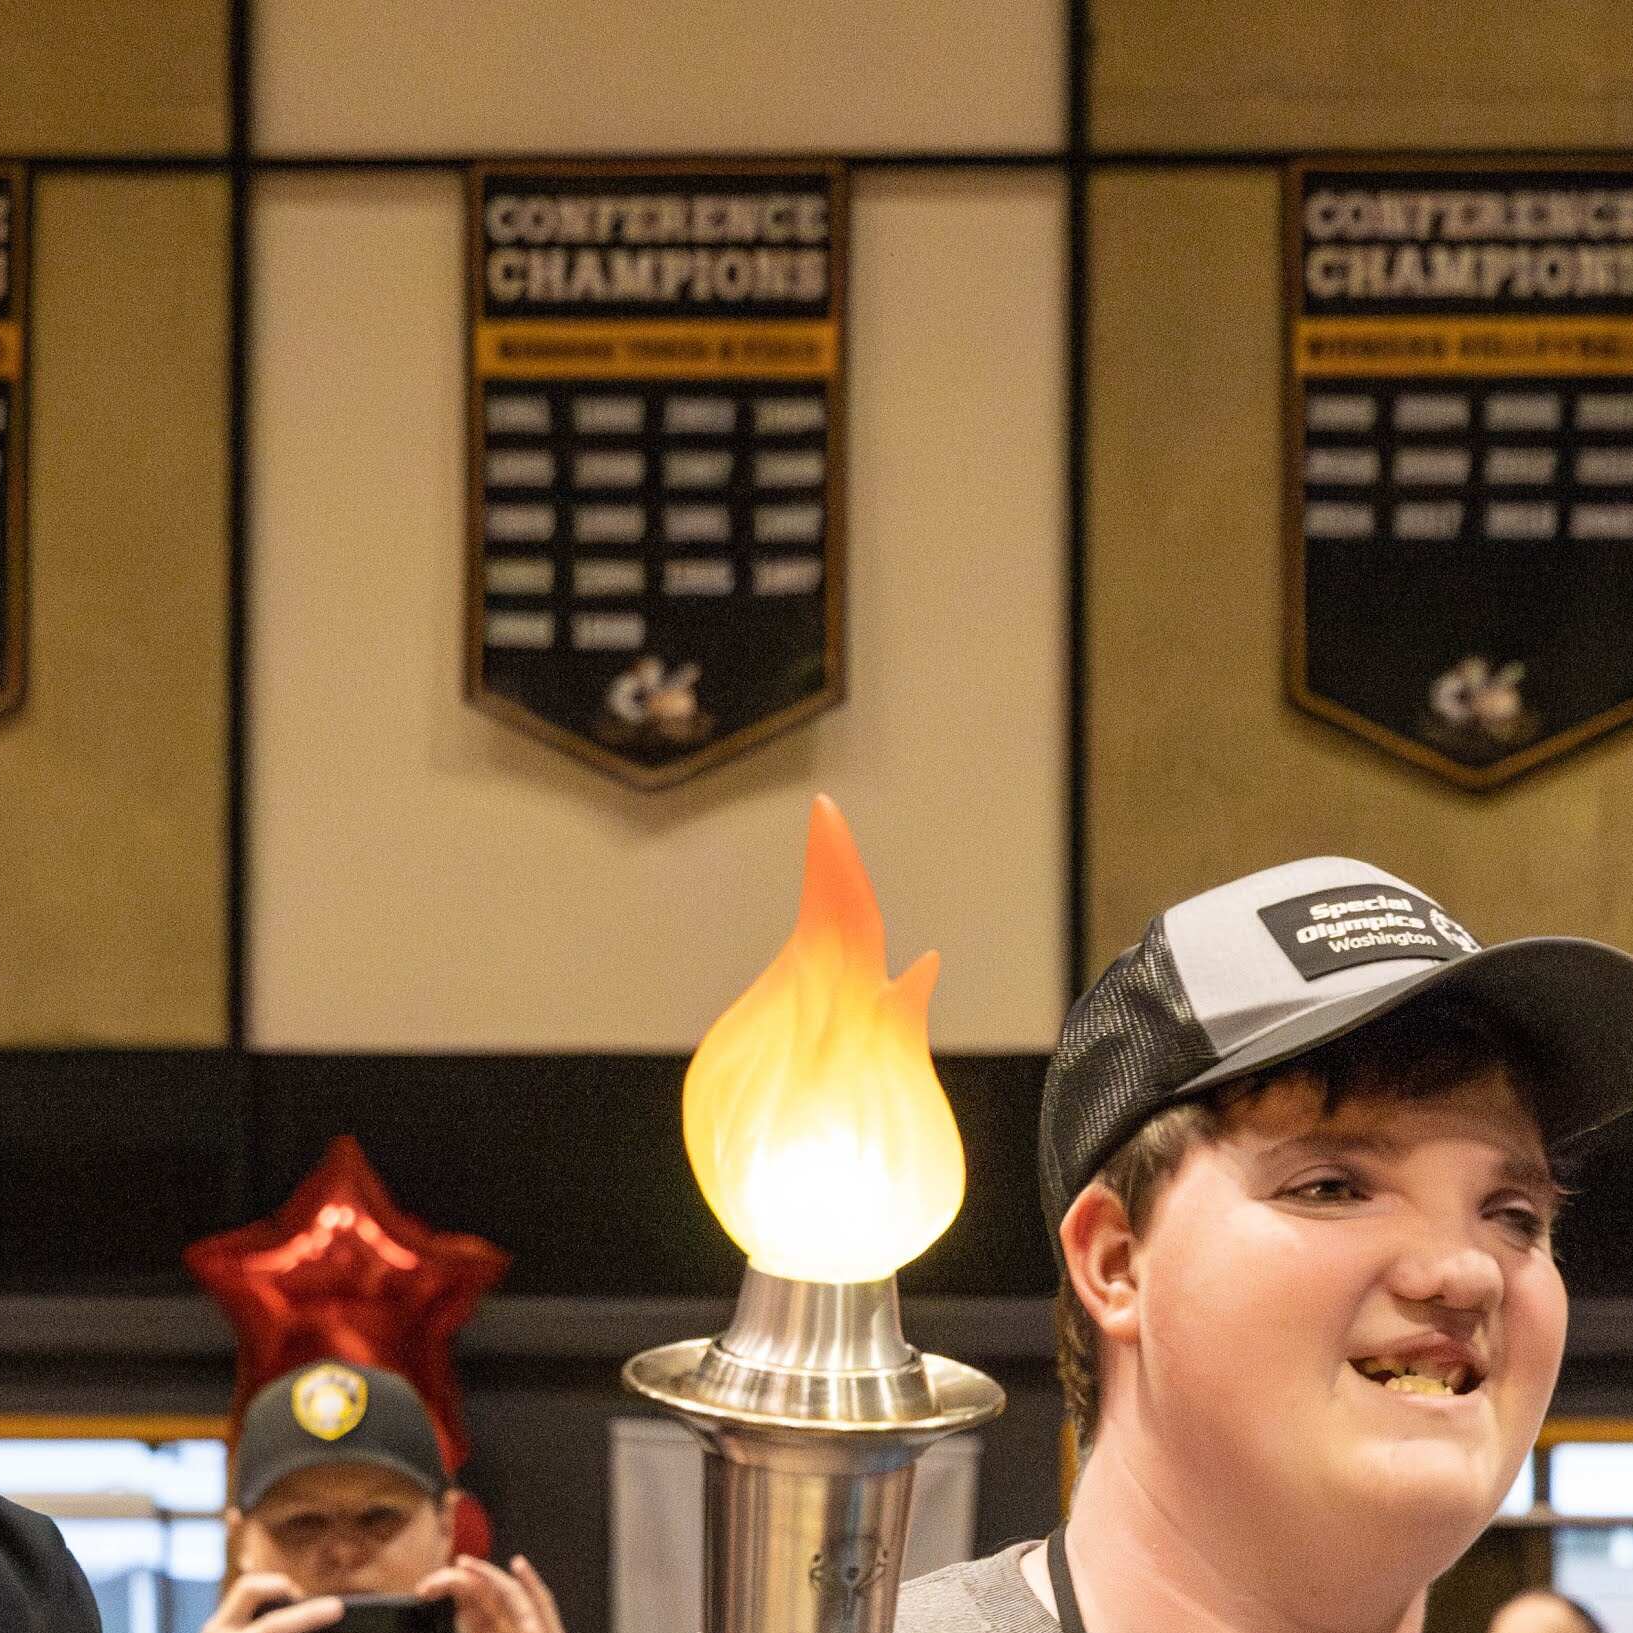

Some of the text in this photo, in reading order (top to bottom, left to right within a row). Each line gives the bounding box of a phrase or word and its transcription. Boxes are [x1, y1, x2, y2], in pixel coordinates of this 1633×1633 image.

[485, 194, 830, 243] CONFERENCE
[485, 248, 828, 301] CHAMPIONS
[1309, 895, 1414, 921] Special
[1296, 912, 1426, 945] Olympics
[1327, 931, 1438, 954] Washington
